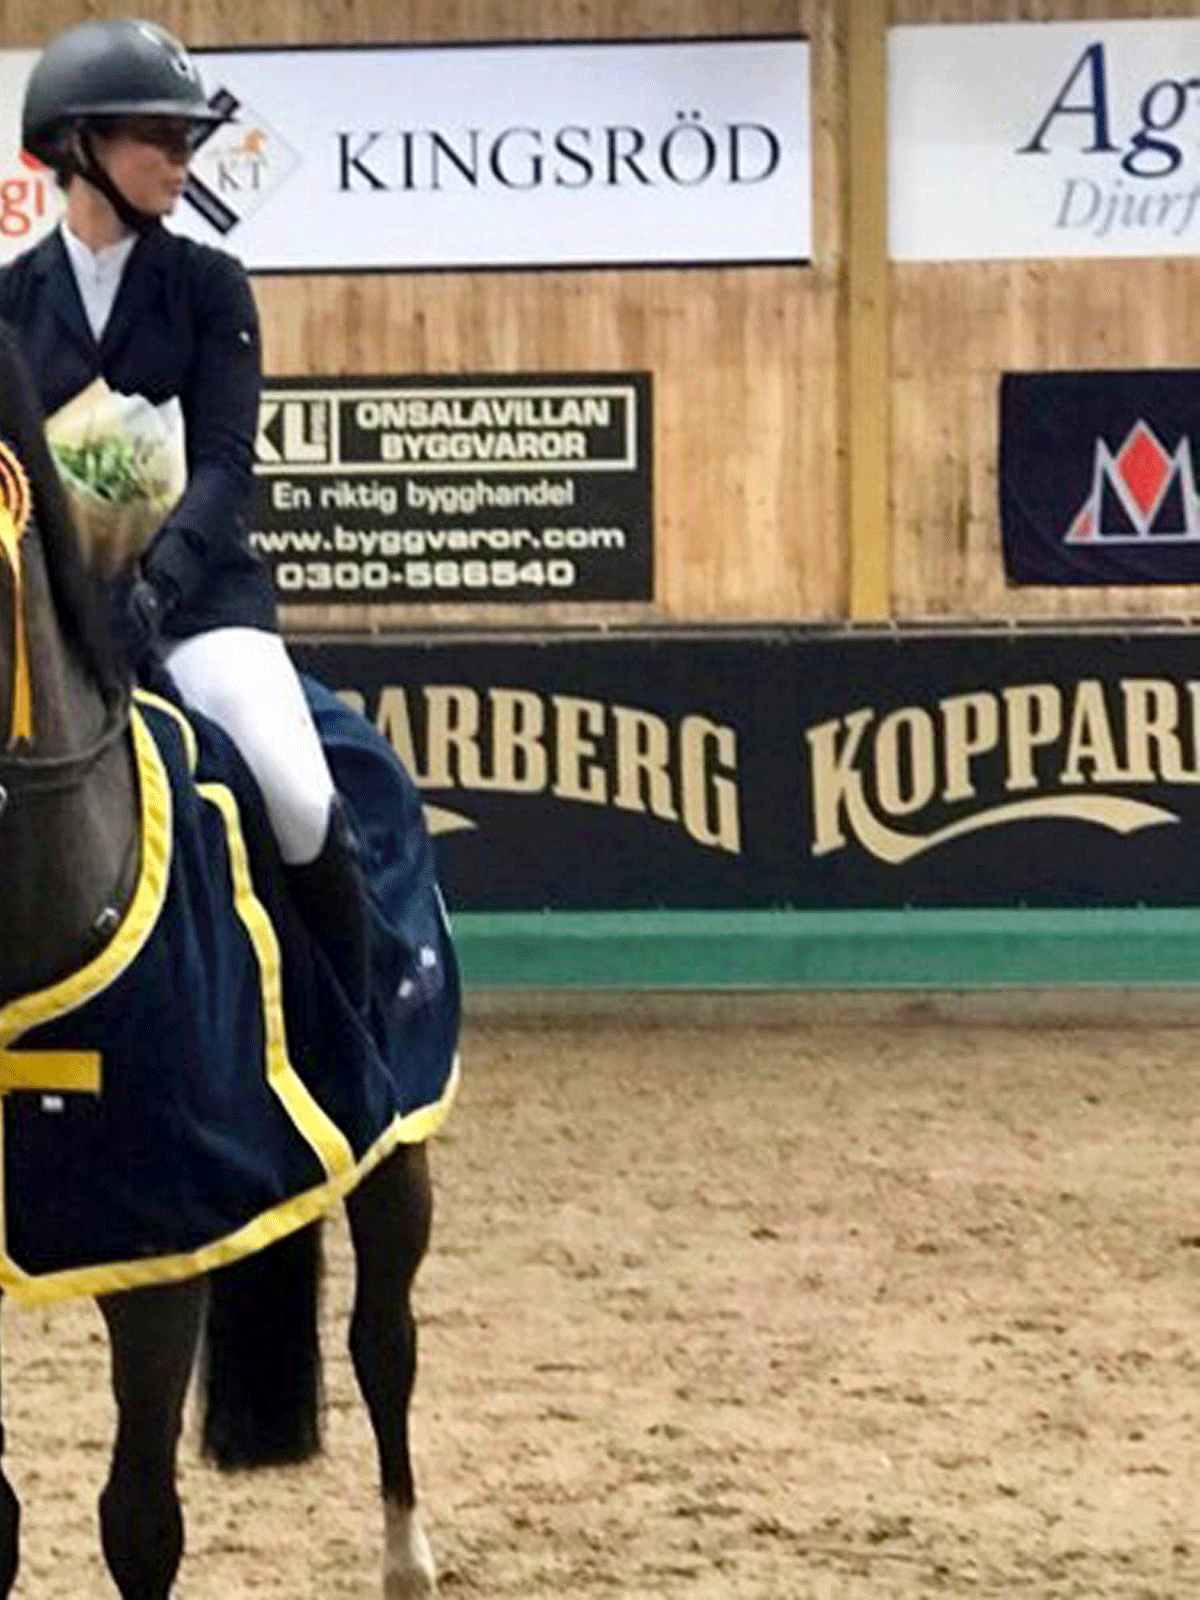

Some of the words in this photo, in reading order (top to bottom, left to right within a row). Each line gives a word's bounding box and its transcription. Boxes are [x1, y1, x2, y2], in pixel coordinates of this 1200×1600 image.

[336, 110, 781, 192] KINGSRÖD
[355, 399, 611, 430] ONSALAVILLAN
[380, 431, 587, 461] BYGGVAROR
[272, 481, 311, 510] En
[320, 480, 398, 515] riktig
[406, 478, 575, 514] bygghandel
[806, 679, 1200, 864] KOPPAR
